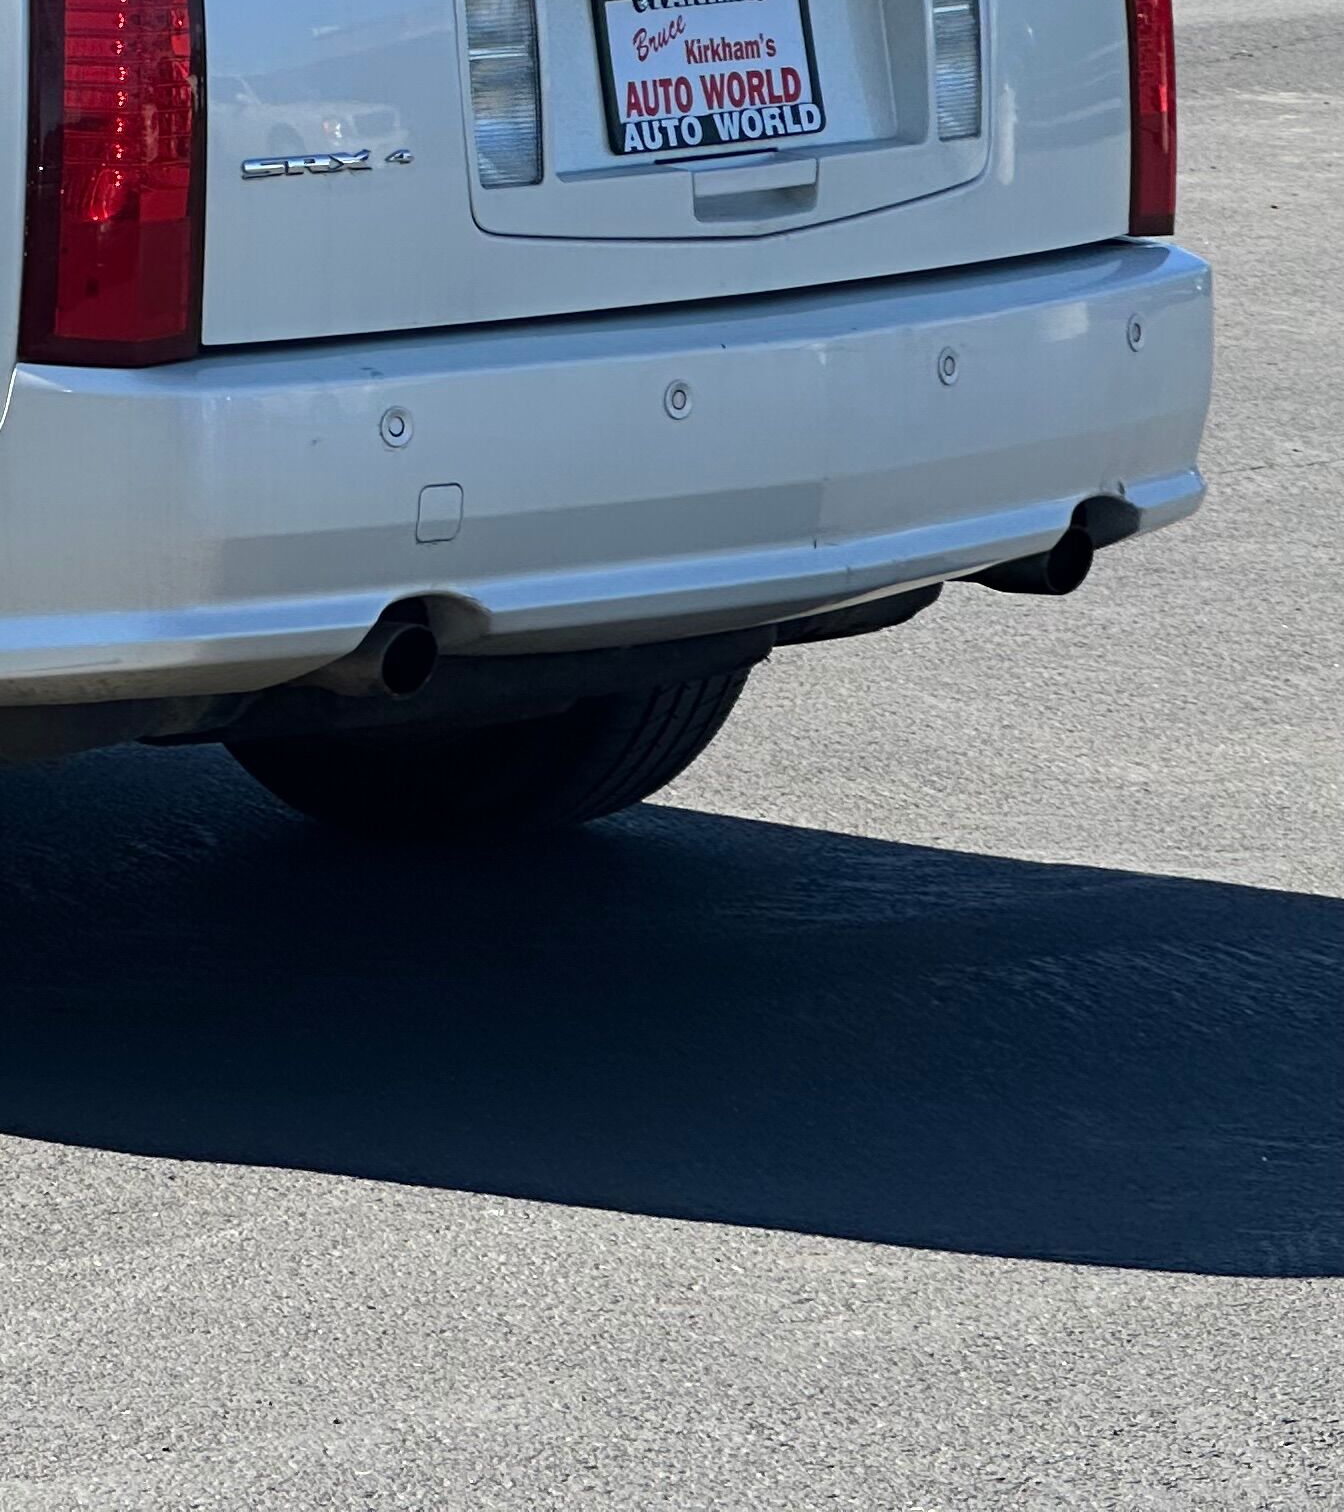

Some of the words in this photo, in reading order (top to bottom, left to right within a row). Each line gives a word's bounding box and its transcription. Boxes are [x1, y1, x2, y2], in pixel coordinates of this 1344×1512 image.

[633, 14, 686, 62] Bruce
[684, 33, 777, 64] Kirkham's
[626, 76, 693, 118] AUTO
[699, 67, 801, 111] WORLD
[624, 116, 703, 152] AUTO
[712, 103, 822, 141] WORLD
[242, 149, 371, 179] SRX
[385, 149, 414, 164] 4
